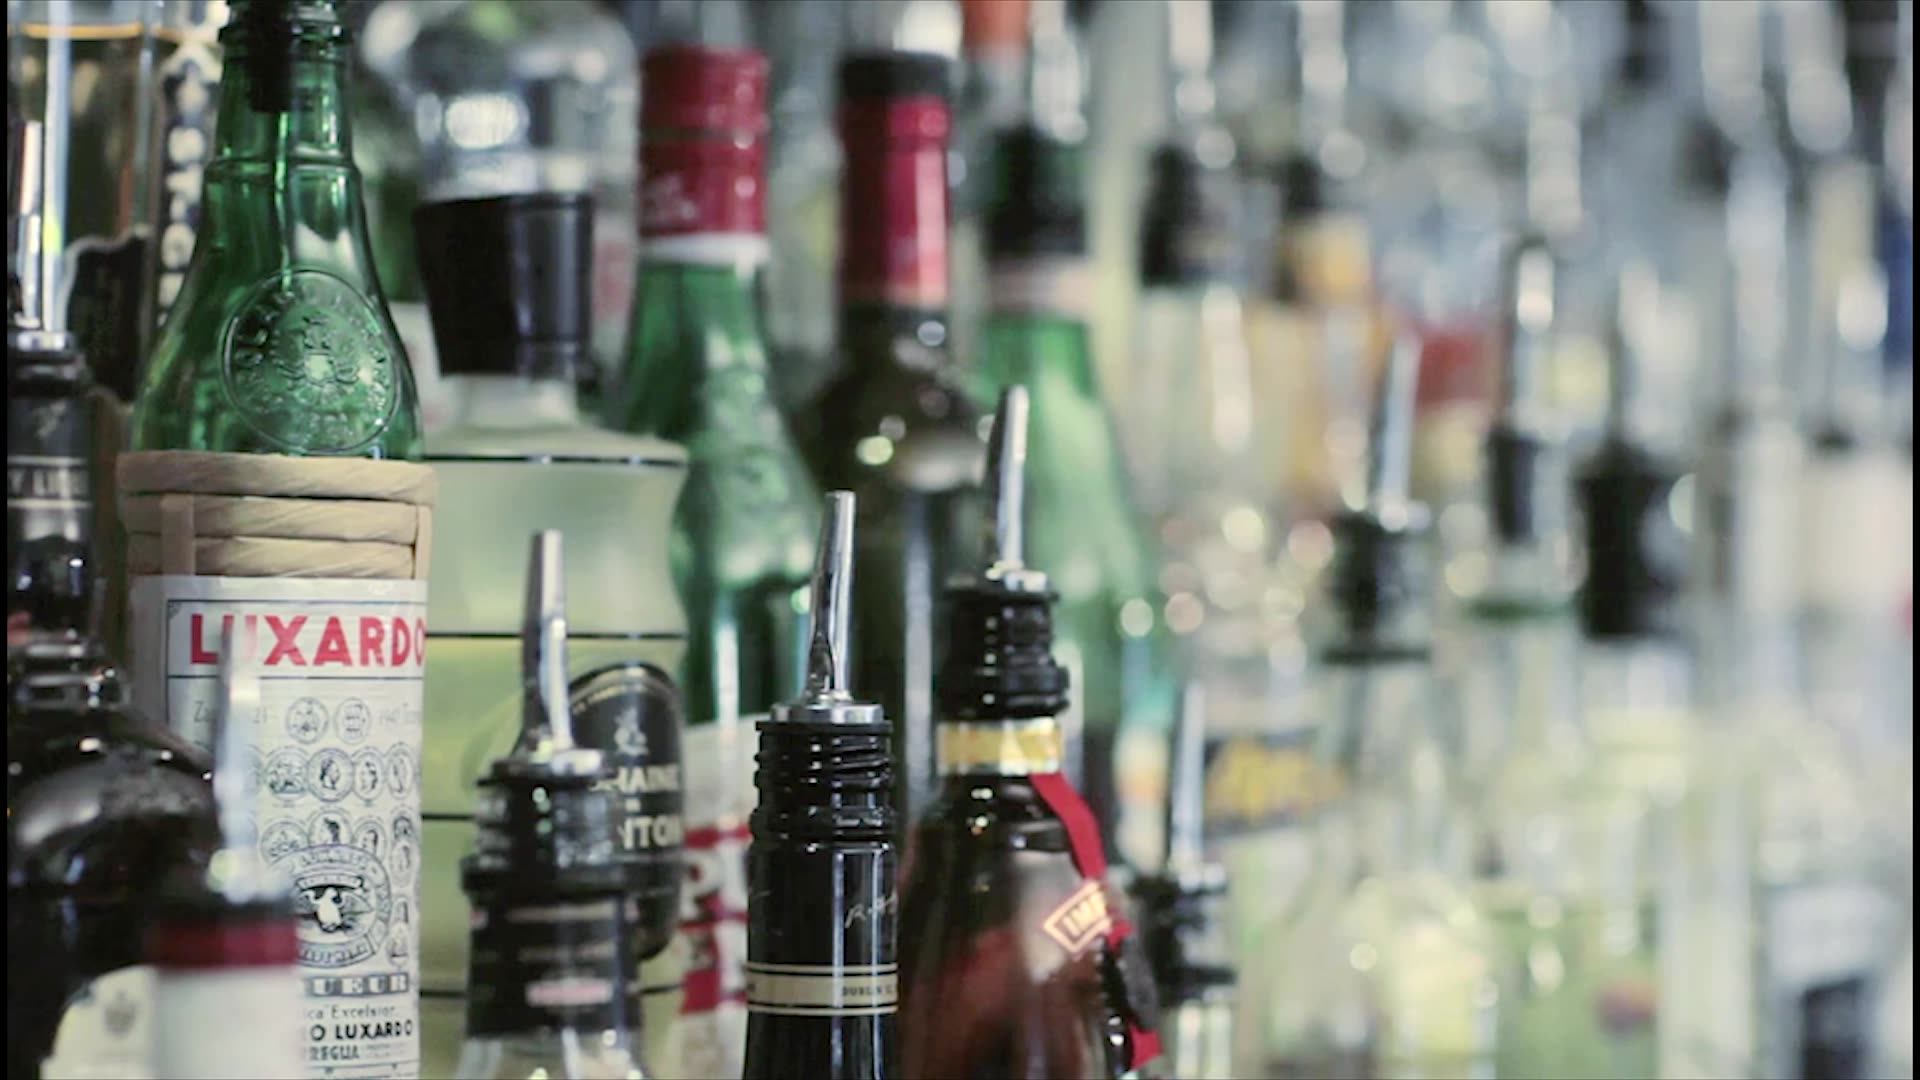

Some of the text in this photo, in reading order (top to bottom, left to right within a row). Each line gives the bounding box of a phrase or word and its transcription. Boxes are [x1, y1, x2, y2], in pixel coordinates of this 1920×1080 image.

[189, 612, 427, 667] LUXARDO
[304, 973, 409, 997] UEUR
[308, 1018, 413, 1042] O LUXARDO
[307, 1044, 361, 1061] REGLIA
